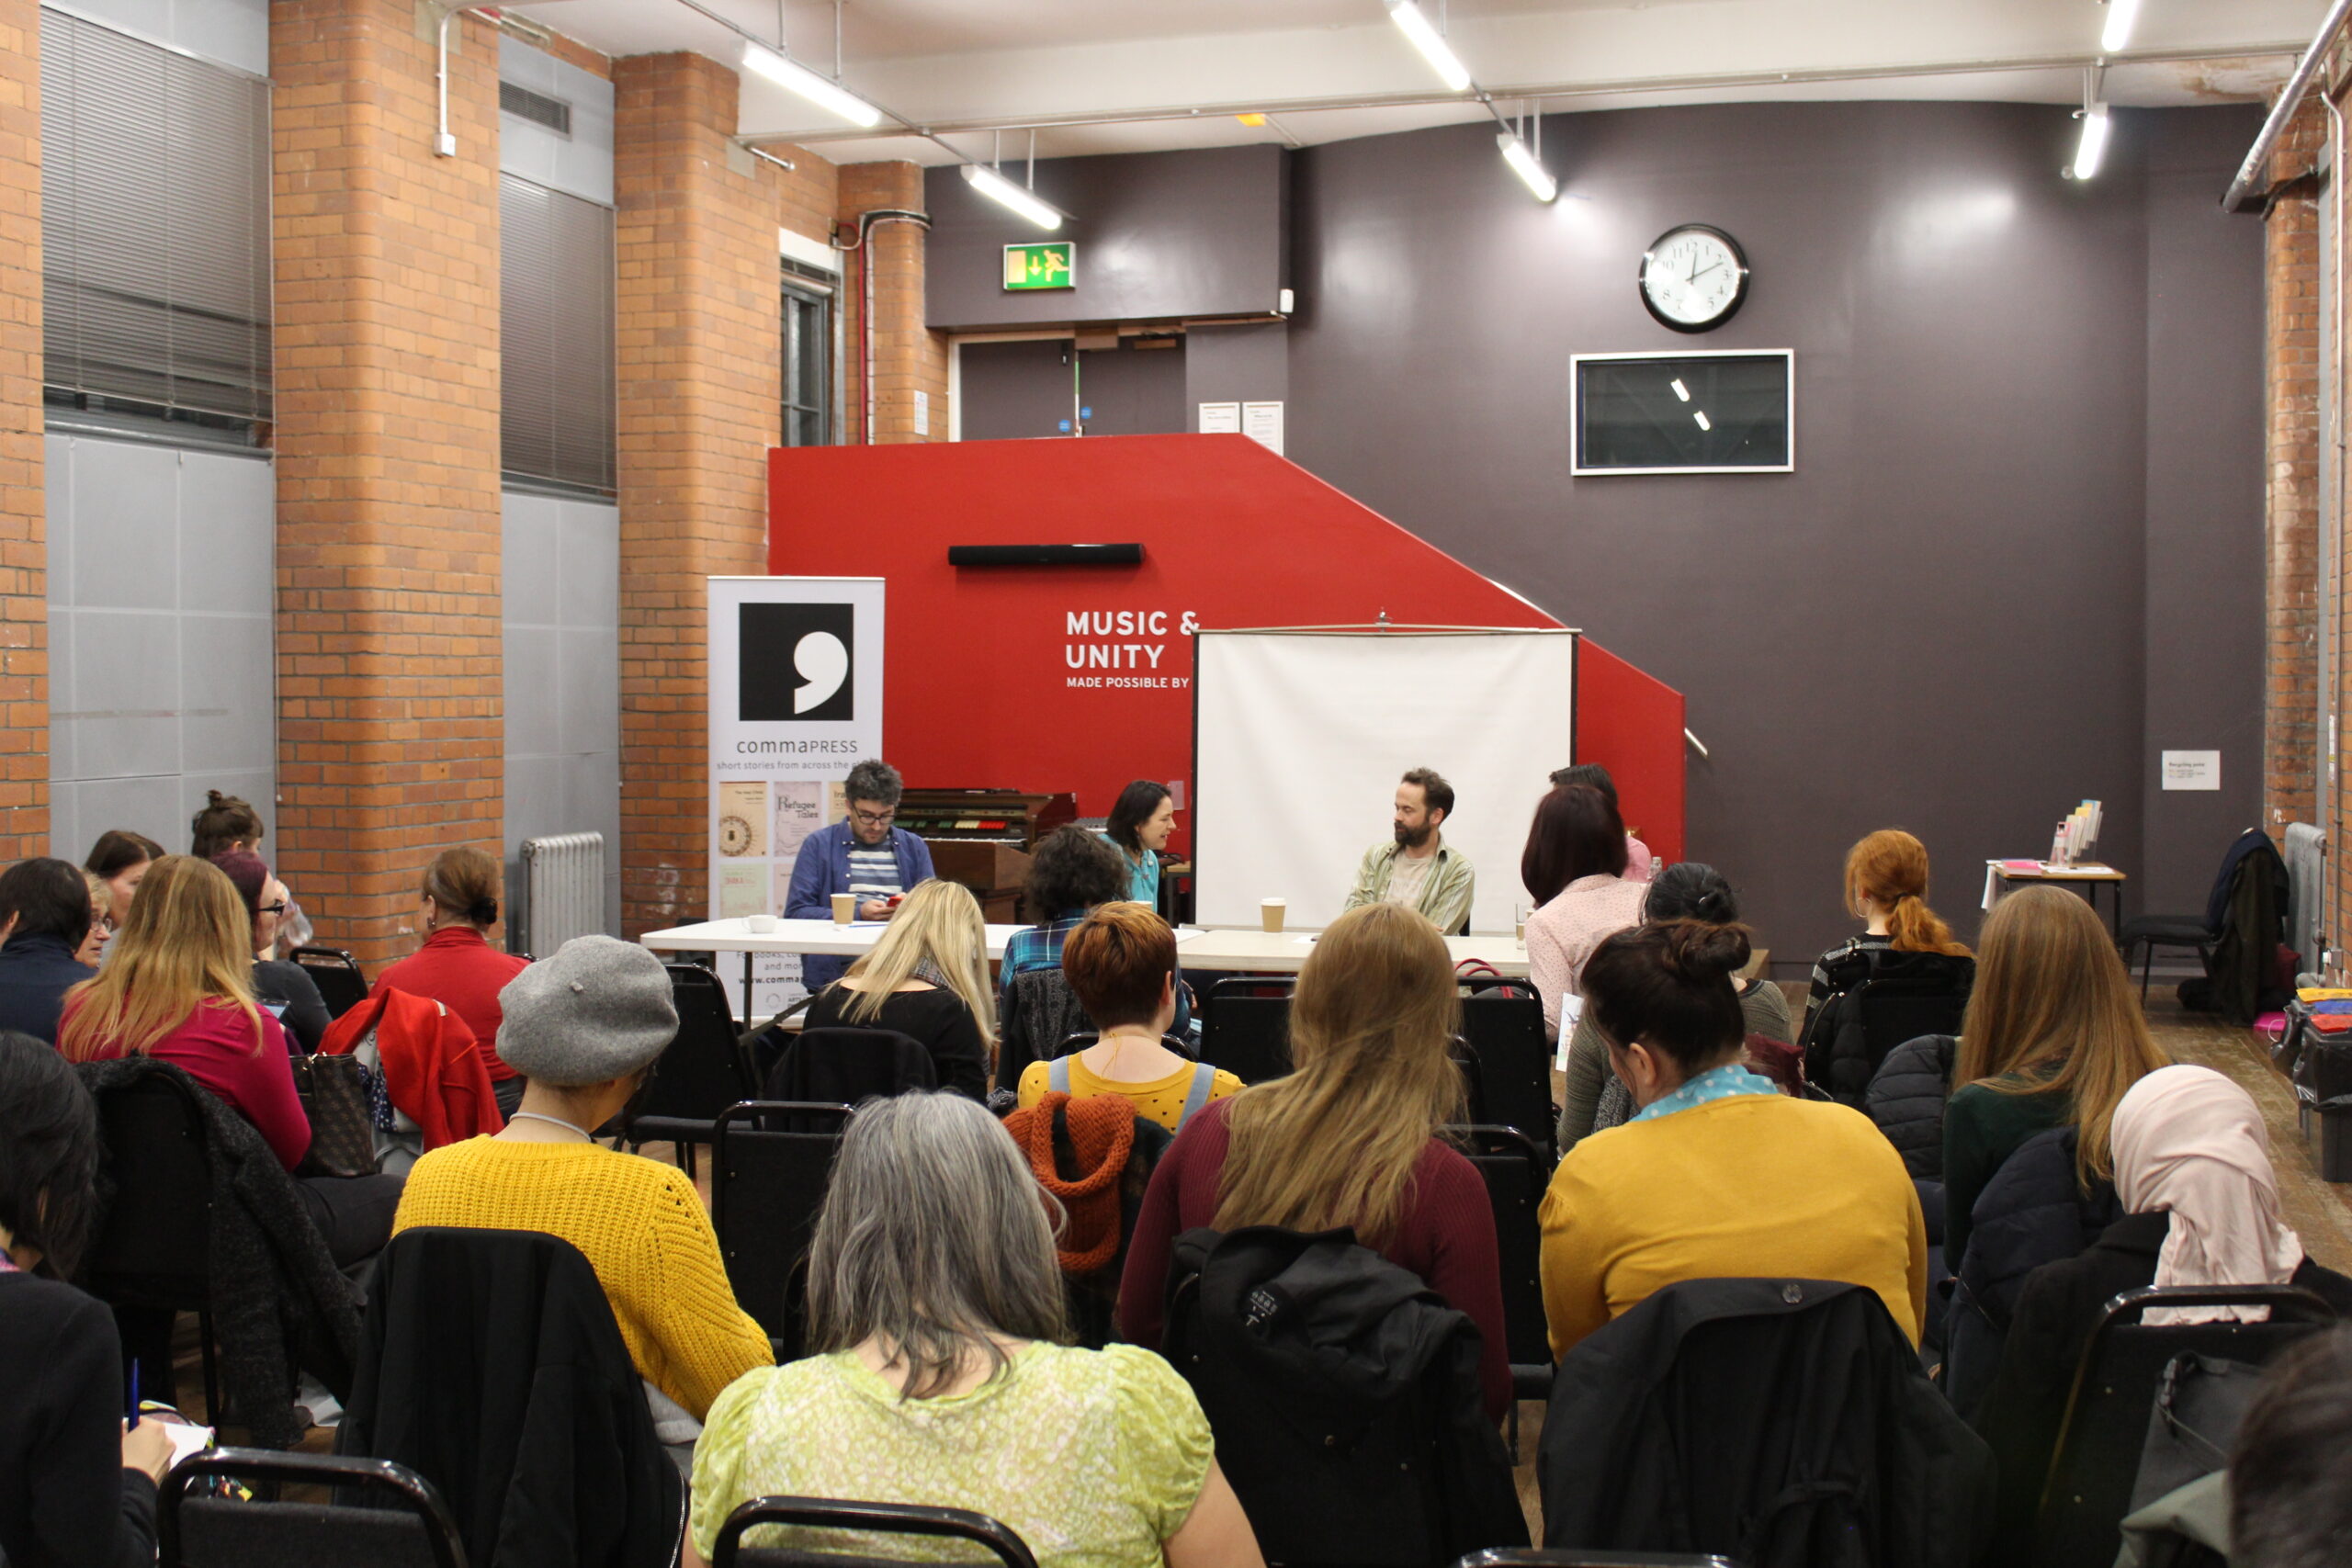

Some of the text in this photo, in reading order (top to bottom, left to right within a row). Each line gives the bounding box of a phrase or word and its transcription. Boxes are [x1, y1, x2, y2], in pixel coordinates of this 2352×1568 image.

[1067, 611, 1200, 636] MUSIC &
[1066, 644, 1165, 669] UNITY
[1067, 677, 1189, 688] MADE POSSIBLE BY
[737, 740, 858, 753] commaPRESS
[717, 761, 741, 770] short
[743, 761, 775, 770] stories
[777, 761, 798, 770] from
[833, 761, 849, 770] the
[777, 795, 816, 811] Refugee
[797, 810, 818, 818] Tales
